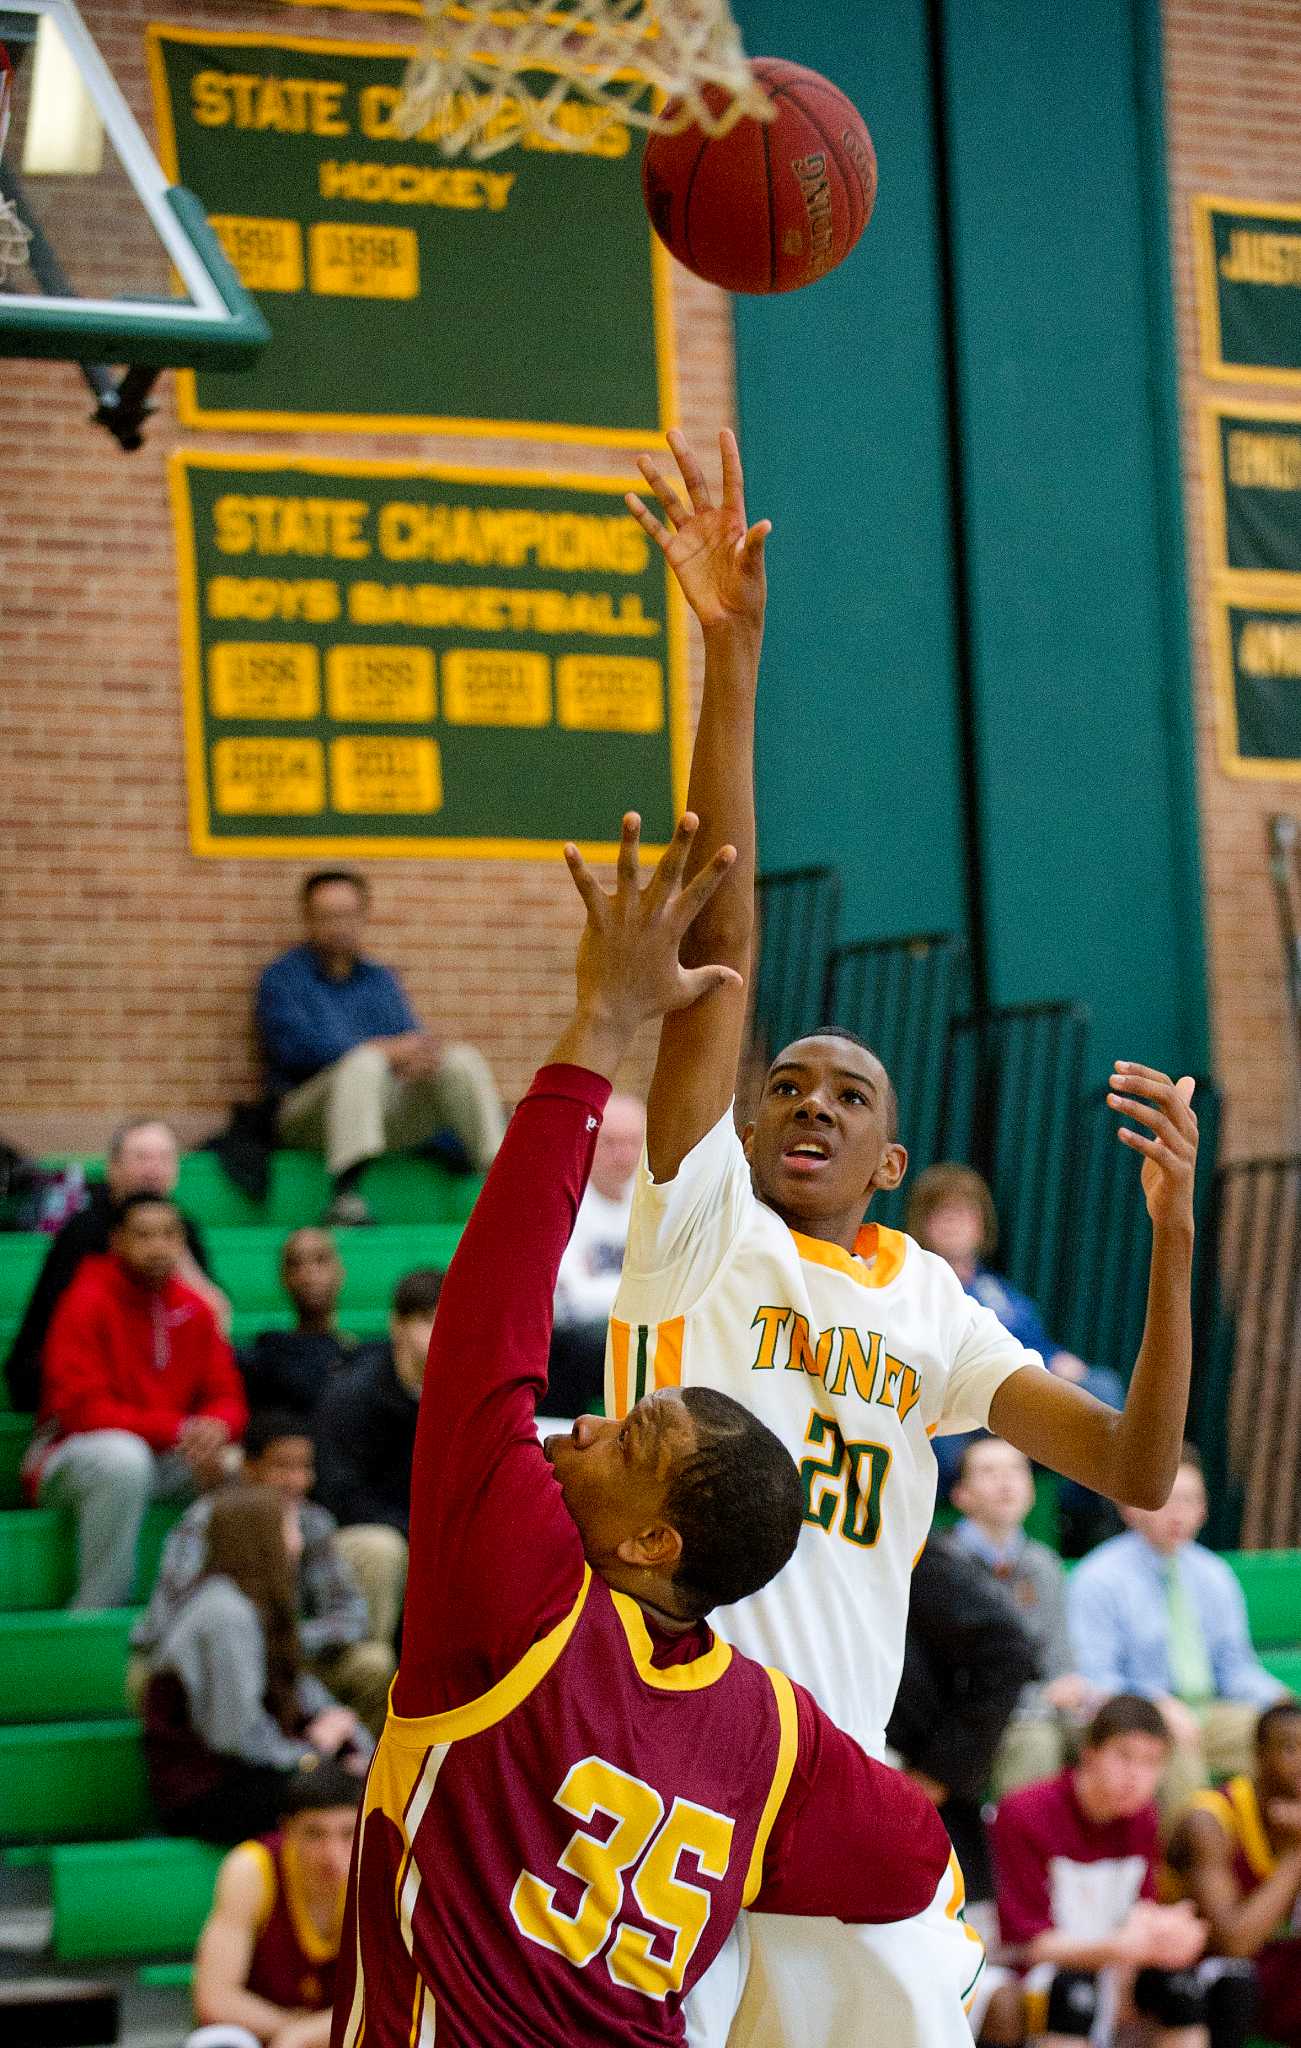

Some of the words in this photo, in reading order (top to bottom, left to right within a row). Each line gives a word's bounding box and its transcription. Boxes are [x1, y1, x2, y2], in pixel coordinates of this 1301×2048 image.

[191, 70, 350, 138] STATE
[360, 86, 630, 159] CMPIONS
[319, 160, 516, 212] HOCKEY
[212, 494, 371, 560] STATE
[378, 500, 649, 575] CHAMPIONS
[205, 574, 342, 623] BOYS
[347, 580, 660, 637] BASKETBALL
[751, 1306, 921, 1424] TRINTY
[799, 1407, 893, 1549] 20
[510, 1756, 735, 2001] 35
